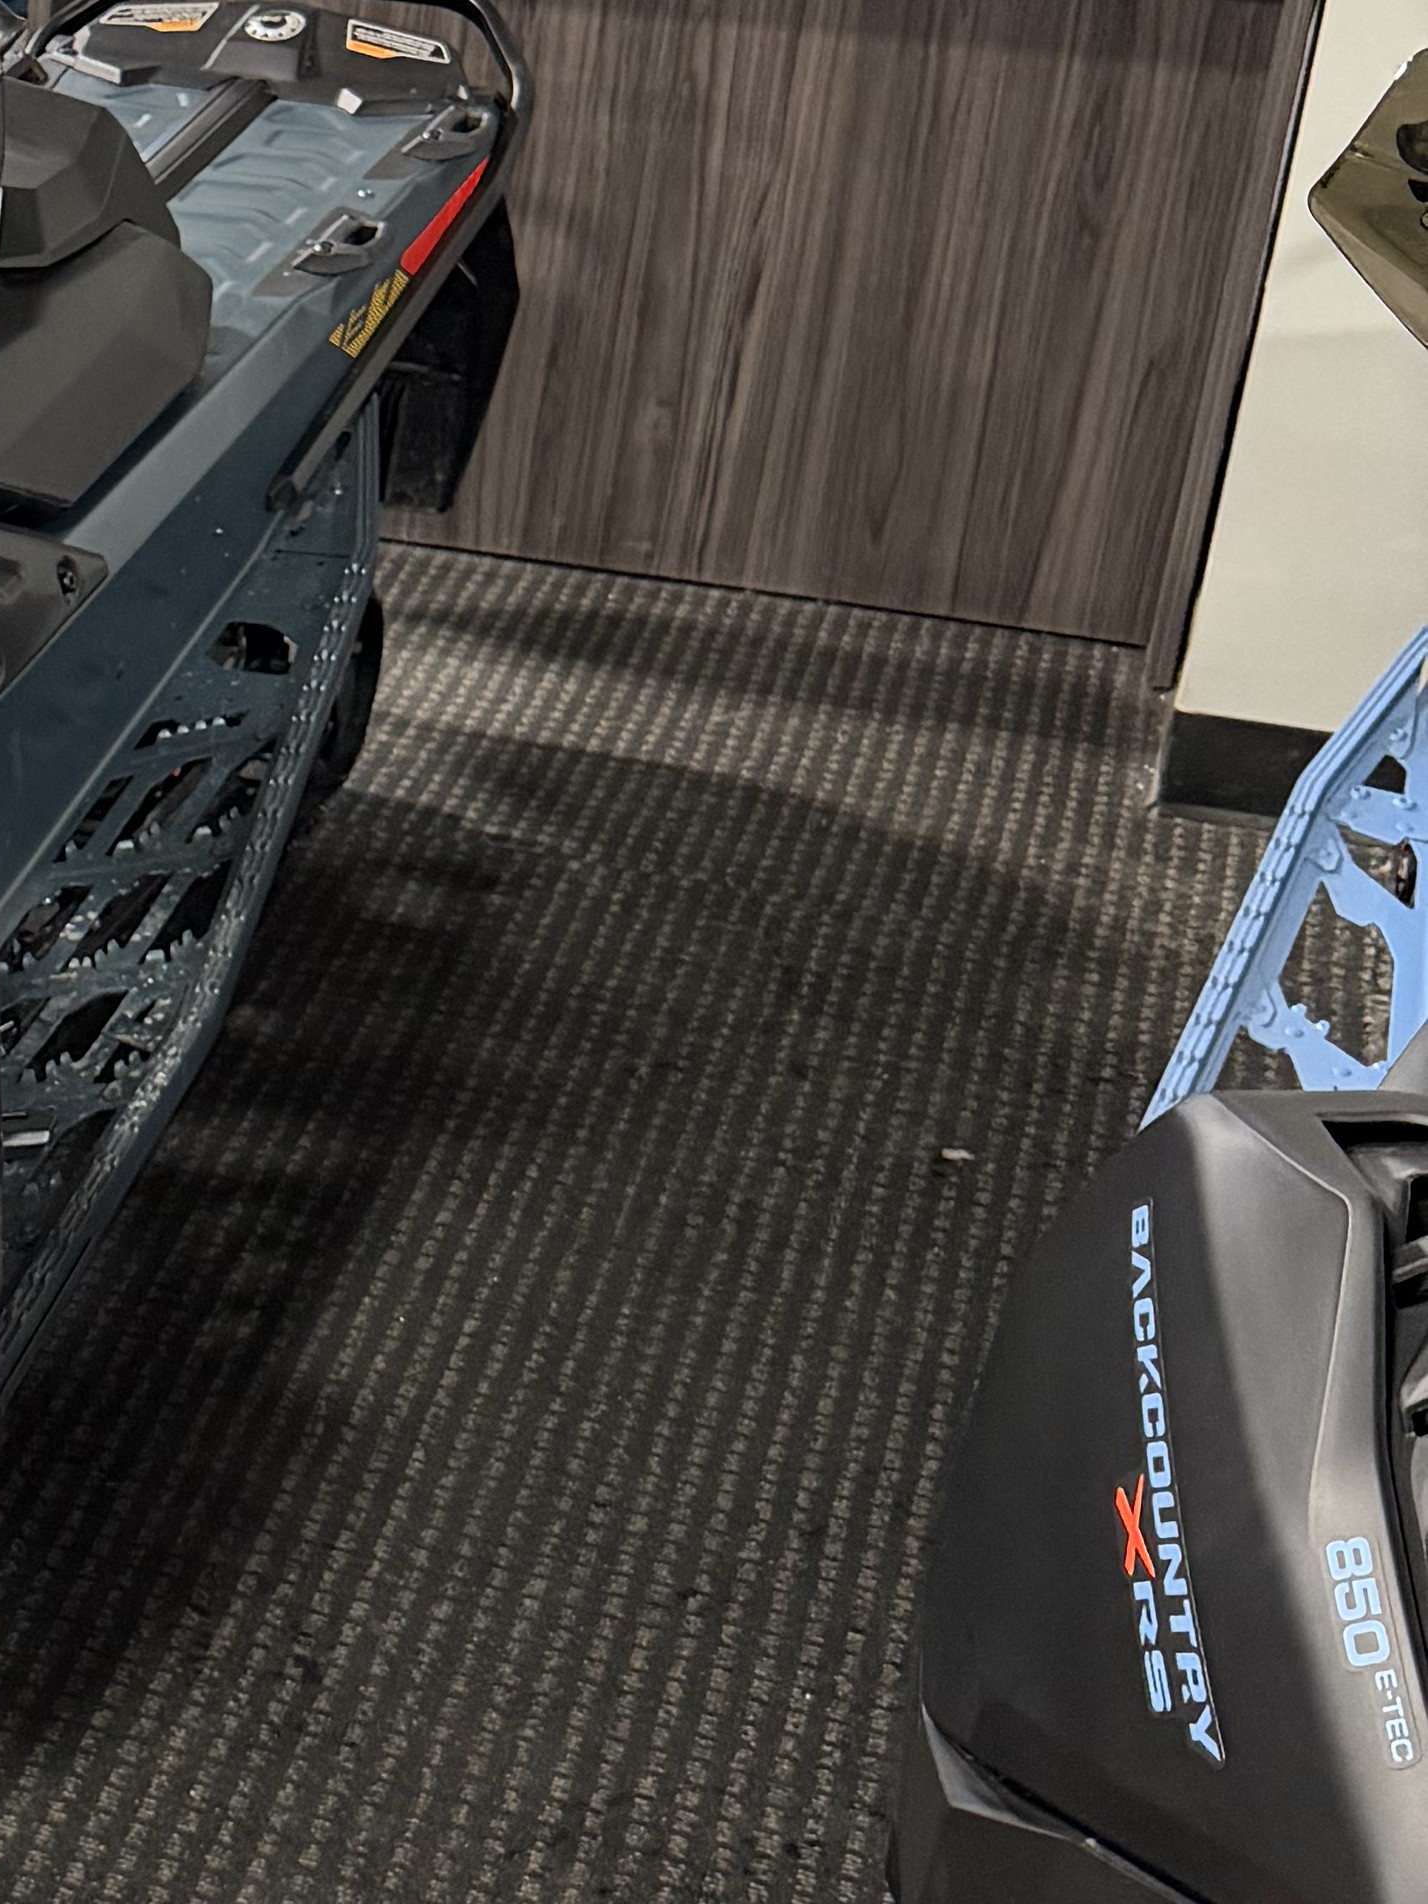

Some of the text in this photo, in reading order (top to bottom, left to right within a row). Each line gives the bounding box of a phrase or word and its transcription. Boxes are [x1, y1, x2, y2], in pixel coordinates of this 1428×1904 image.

[1115, 1473, 1172, 1713] X RS
[1131, 1204, 1224, 1763] BACKCOUNTRY
[1325, 1536, 1414, 1764] 850 E-TEC
